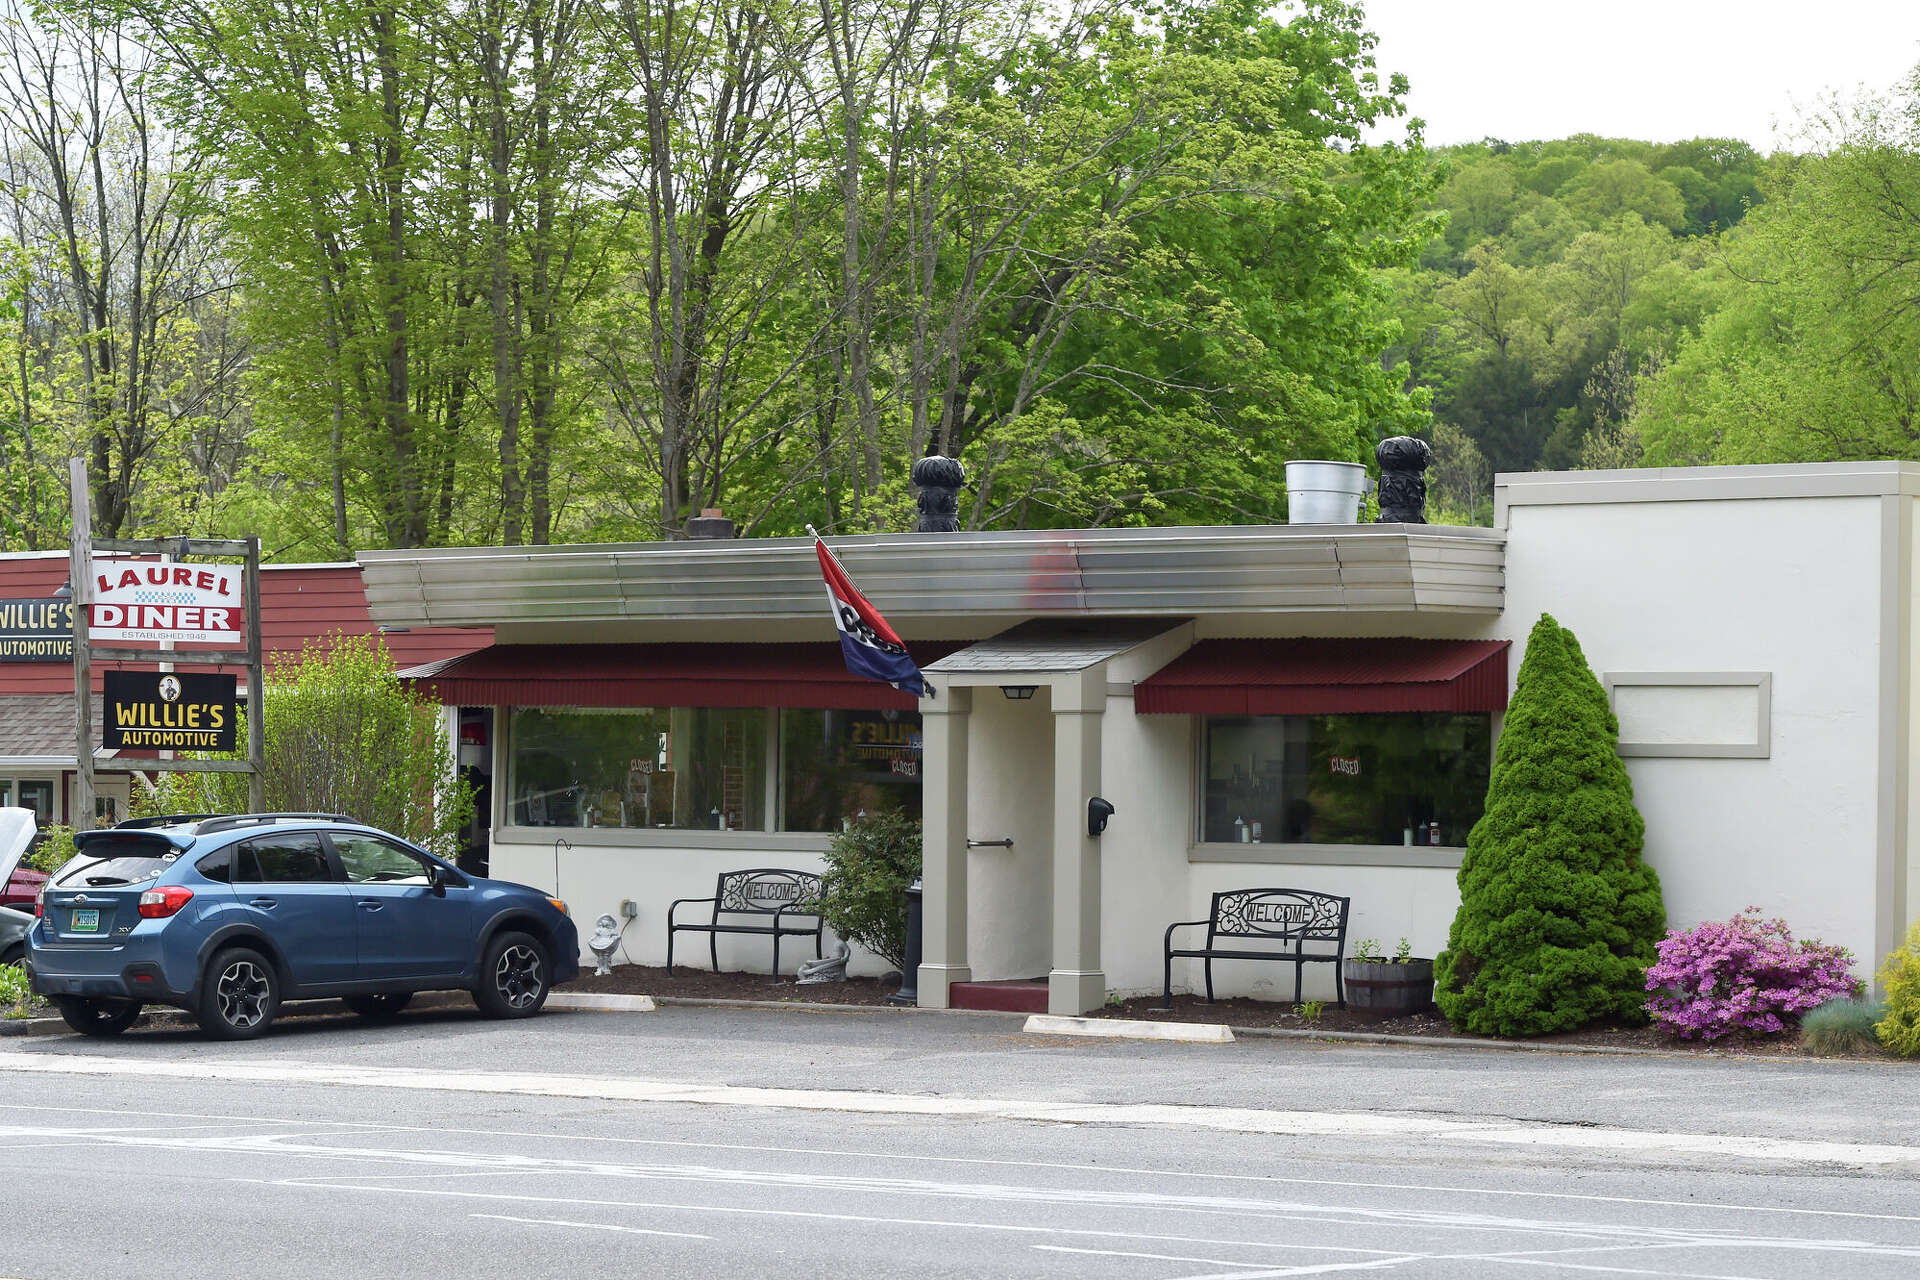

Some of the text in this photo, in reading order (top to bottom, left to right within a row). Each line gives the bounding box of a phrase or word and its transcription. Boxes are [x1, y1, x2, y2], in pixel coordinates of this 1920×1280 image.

[98, 567, 230, 596] LAUREL
[93, 604, 231, 630] DINER
[121, 631, 184, 640] ESTABLISHED
[115, 702, 224, 728] WILLIE'S
[122, 731, 218, 746] AUTOMOTIVE
[630, 759, 653, 774] CLOSED
[891, 759, 917, 776] CLOSED
[1331, 758, 1359, 775] CLOSED
[746, 883, 798, 900] WELCOME
[1246, 903, 1311, 923] WELCOME
